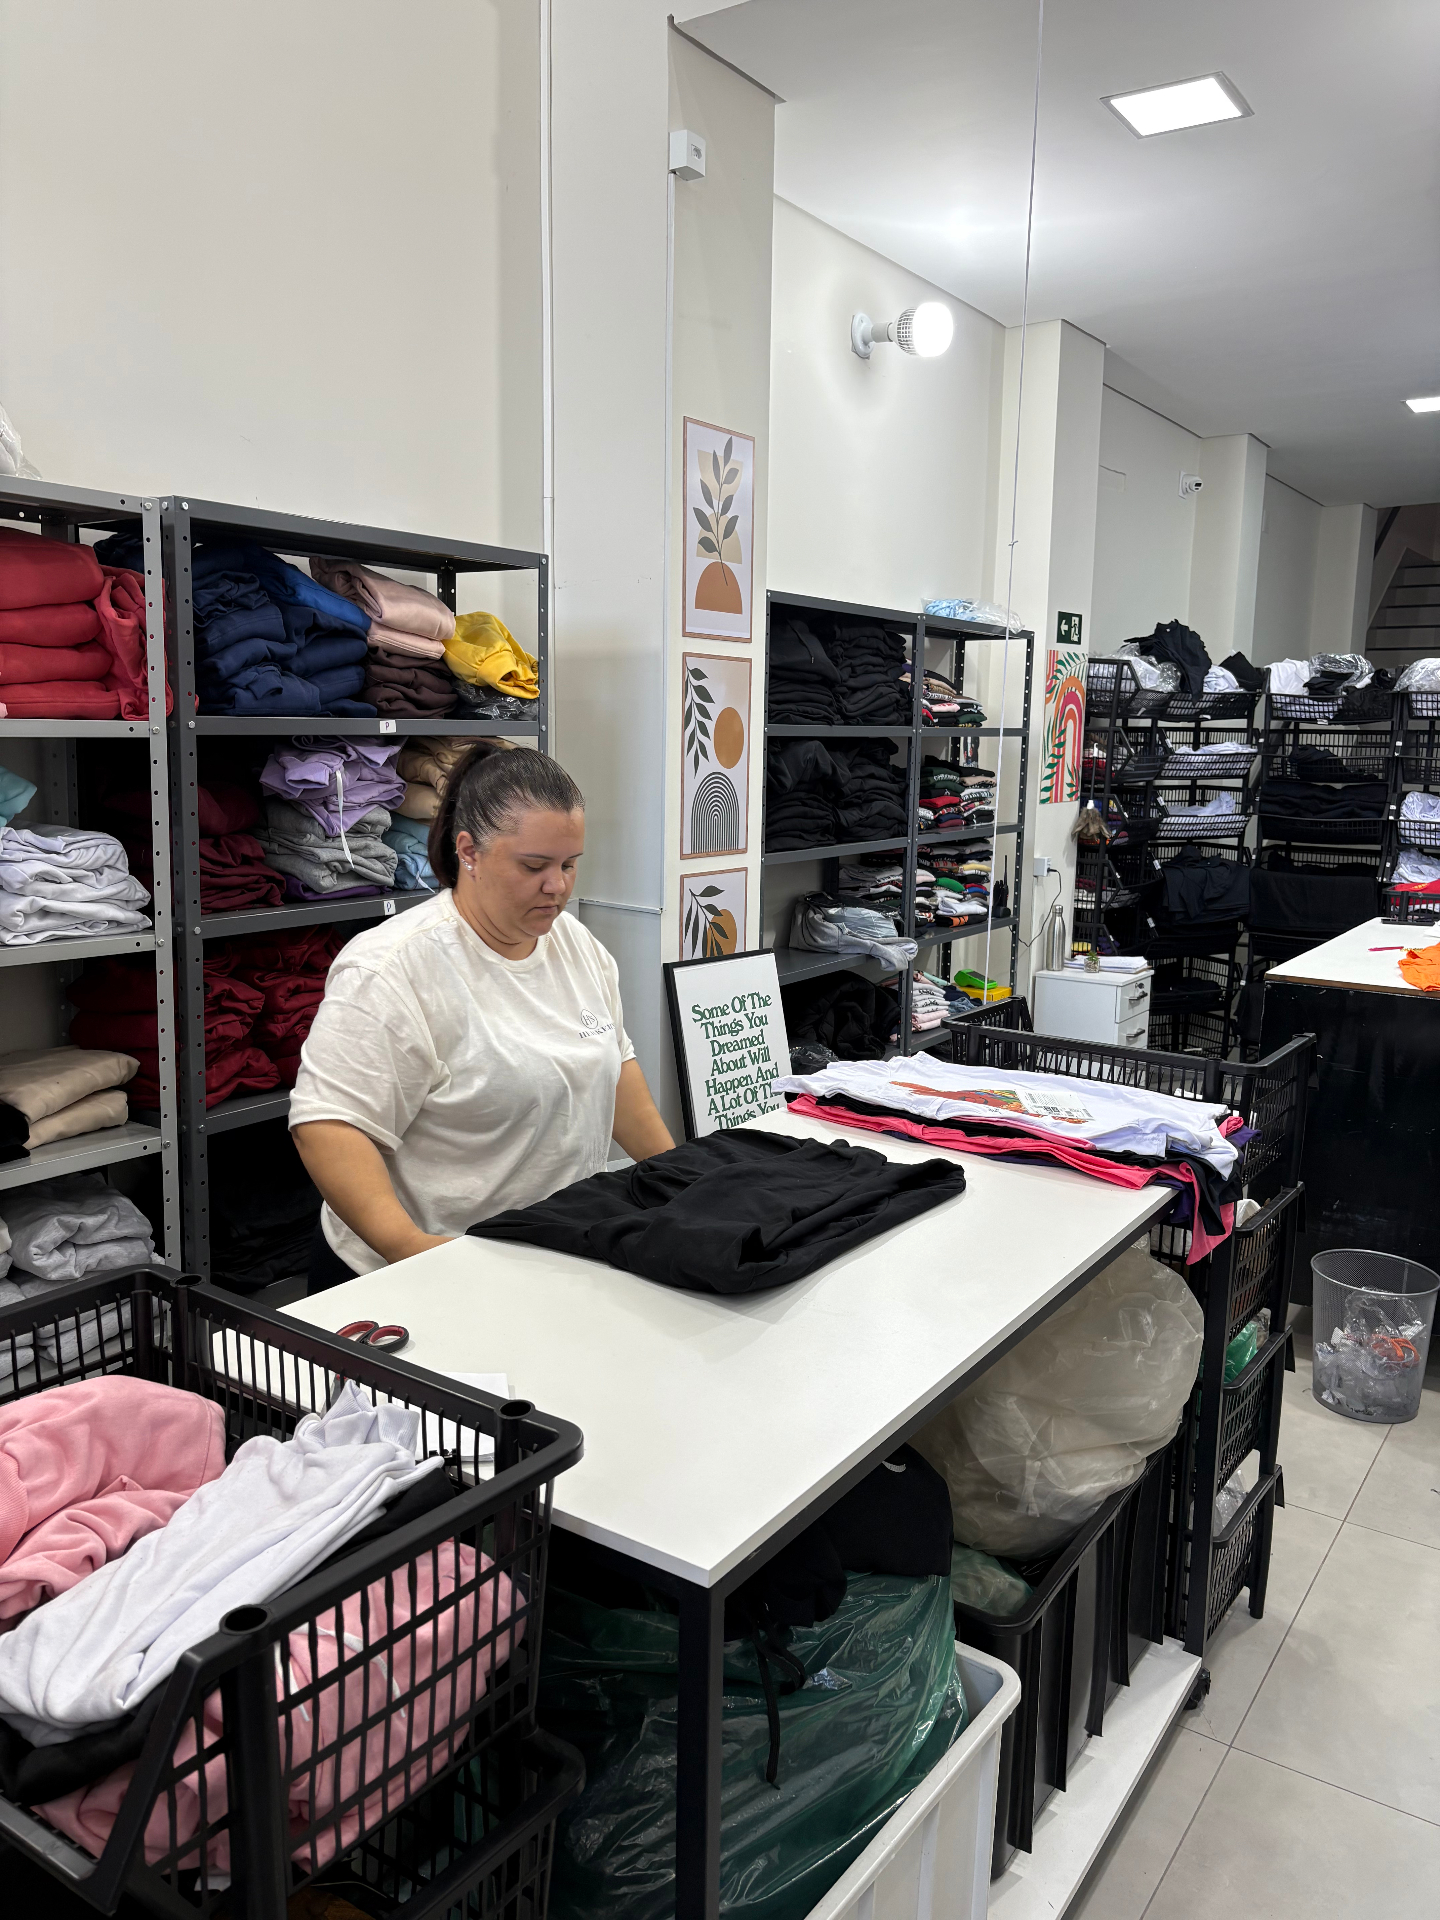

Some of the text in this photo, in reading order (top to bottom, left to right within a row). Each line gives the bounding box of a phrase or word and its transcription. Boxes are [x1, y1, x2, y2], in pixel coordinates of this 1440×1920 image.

[692, 992, 772, 1024] Some Of The
[700, 1012, 769, 1040] Things You
[710, 1029, 765, 1057] Dreamed
[710, 1046, 772, 1076] About Will
[705, 1062, 780, 1097] Happen And
[708, 1098, 720, 1116] A
[720, 1092, 742, 1112] Lot
[744, 1086, 759, 1104] Of
